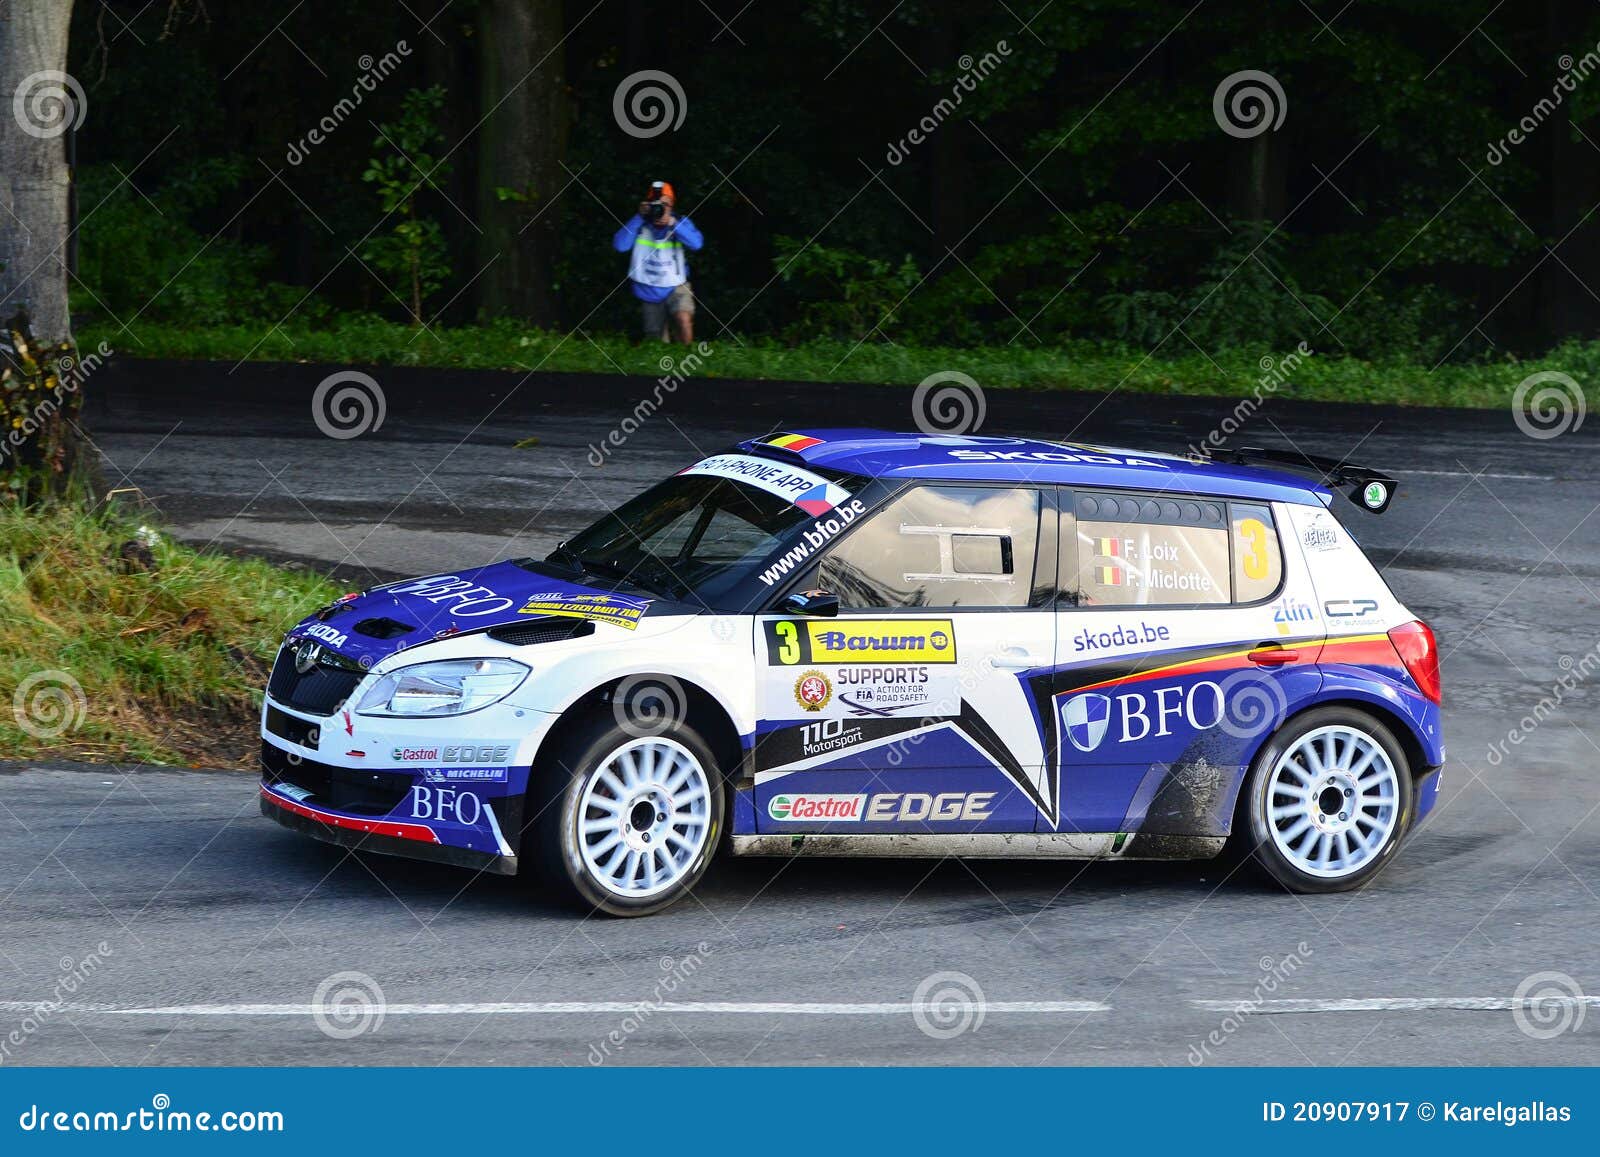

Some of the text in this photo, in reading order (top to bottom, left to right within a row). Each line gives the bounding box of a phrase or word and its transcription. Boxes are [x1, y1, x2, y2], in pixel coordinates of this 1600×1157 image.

[771, 474, 813, 493] APP
[758, 499, 866, 586] www.bfo.be
[1143, 540, 1179, 561] Loix
[1240, 518, 1269, 580] 3
[1148, 569, 1211, 591] Miclotte
[776, 621, 800, 665] 3
[816, 631, 926, 651] Barum
[1074, 622, 1170, 651] skoda.be
[837, 667, 929, 685] SUPPORTS
[876, 685, 906, 694] ACTION
[908, 685, 924, 693] FOR
[876, 693, 929, 702] ROAD SAFETY
[1115, 681, 1225, 743] BFO
[402, 745, 511, 763] Castrol EDGE
[803, 731, 863, 756] Motorsport
[446, 769, 504, 778] MICHELIN
[410, 785, 480, 825] BFO
[791, 791, 999, 822] Castrol EDGE
